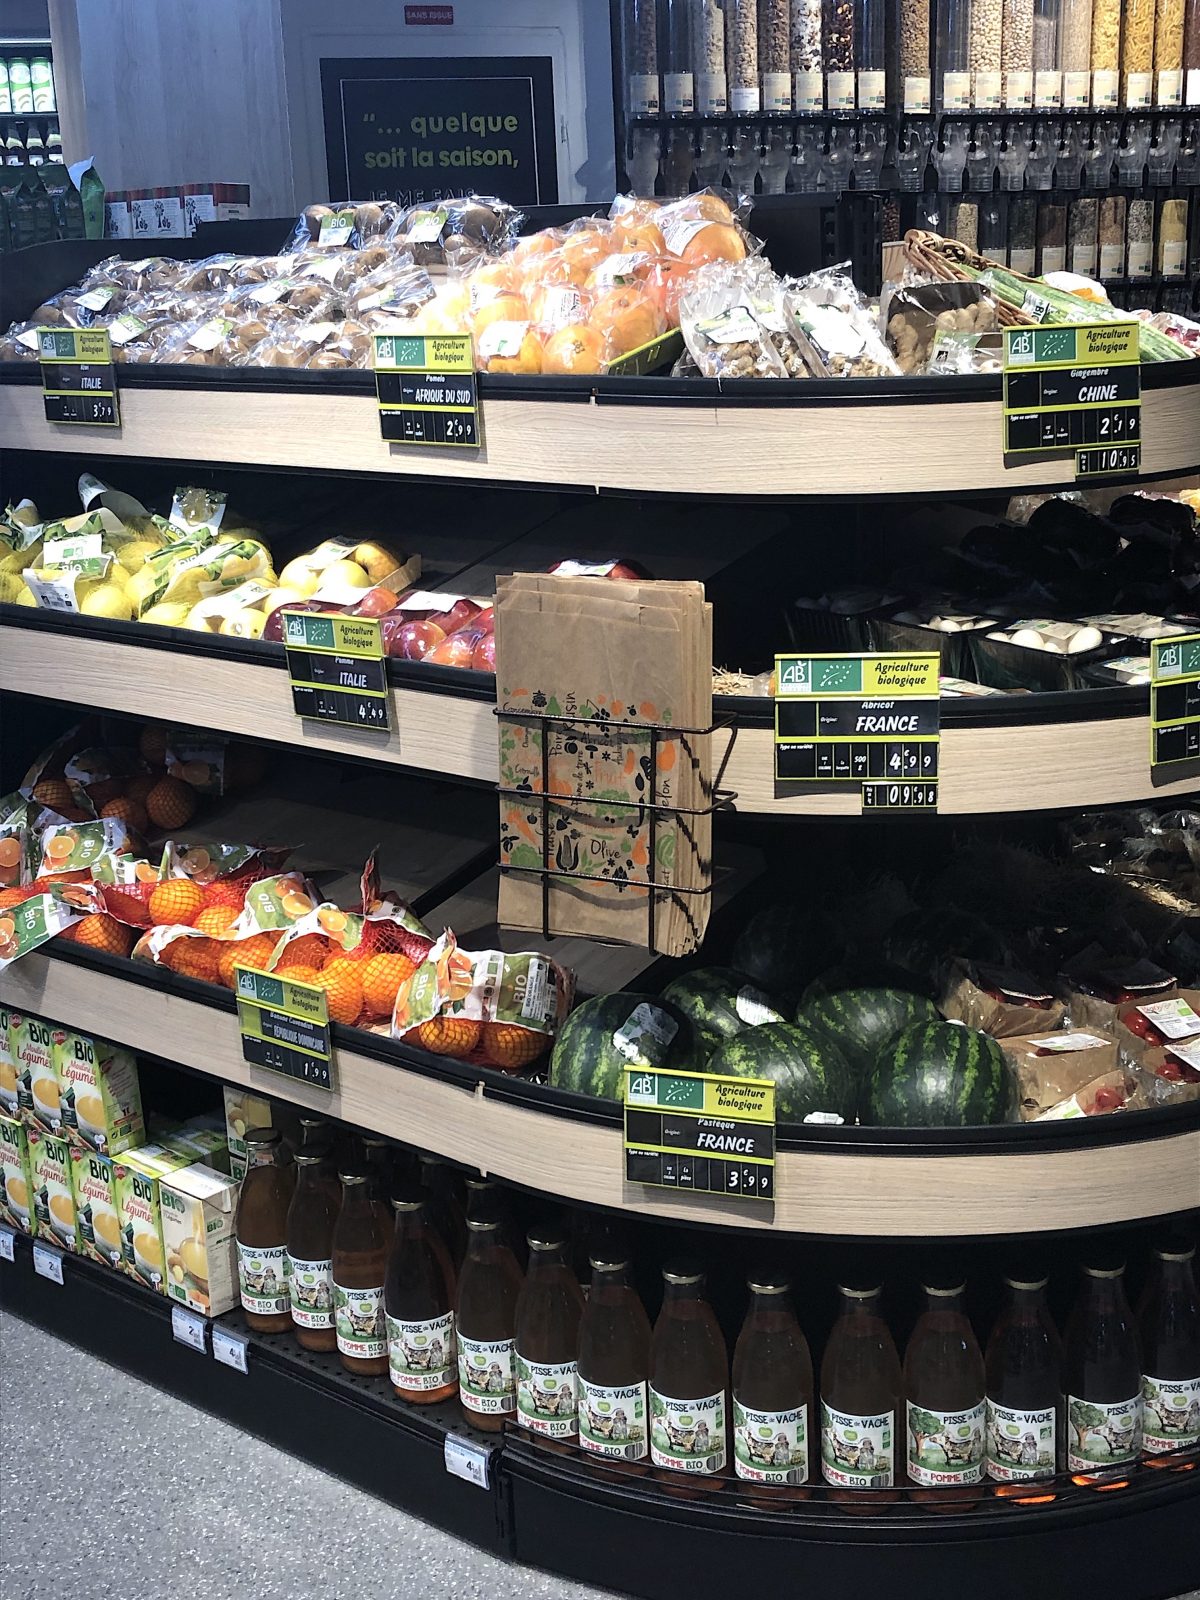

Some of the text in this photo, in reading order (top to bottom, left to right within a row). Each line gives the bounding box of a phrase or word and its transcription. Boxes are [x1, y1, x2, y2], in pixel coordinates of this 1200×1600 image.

[410, 112, 519, 138] quelque
[364, 146, 519, 169] soit la saison,
[330, 217, 346, 228] BIO
[377, 340, 466, 357] AB Agriculture
[1011, 329, 1131, 354] AB Agriculture
[1088, 342, 1128, 354] biologique
[434, 353, 464, 363] biologique
[1070, 368, 1110, 379] Gingembre
[81, 377, 102, 389] ITALIE
[415, 389, 471, 404] AFRIQUE DU SUD
[1078, 384, 1118, 402] CHINE
[288, 620, 374, 636] AB Agriculture
[343, 637, 373, 648] biologique
[1159, 649, 1177, 667] AB
[782, 661, 930, 682] AB Agriculture
[339, 672, 367, 688] ITALIE
[877, 675, 926, 687] biologique
[861, 701, 895, 709] Abricot
[855, 715, 919, 732] FRANCE
[854, 755, 867, 763] 500
[81, 840, 95, 859] BIO
[590, 838, 621, 859] Olive
[258, 893, 275, 913] BIO
[240, 974, 320, 1002] AB Agriculture
[415, 973, 429, 1000] BIO
[513, 974, 527, 1003] BIO
[292, 997, 319, 1012] biologique
[28, 1022, 50, 1047] Bio
[74, 1040, 94, 1064] Bio
[631, 1076, 766, 1098] AB Agriculture
[717, 1098, 763, 1111] biologique
[1, 1124, 19, 1148] Bio
[696, 1133, 755, 1153] FRANCE
[45, 1140, 65, 1165] Bio
[89, 1159, 109, 1183] Bio
[133, 1177, 152, 1203] Bio
[161, 1190, 185, 1214] BIO
[207, 1219, 223, 1233] BIO
[263, 1248, 287, 1259] VACHE
[316, 1263, 332, 1272] VAC
[347, 1291, 368, 1300] PISSE
[257, 1301, 272, 1309] BIO
[311, 1315, 326, 1324] BIO
[401, 1315, 453, 1333] PISSE VACHE
[343, 1341, 384, 1352] POMME BIO
[463, 1341, 515, 1353] PISSE VACHE
[397, 1372, 439, 1385] POMME BIO
[530, 1365, 577, 1376] PISSE VAC
[586, 1385, 641, 1399] PISSE VACHE
[1159, 1383, 1184, 1393] PISSE
[481, 1399, 497, 1408] BIO
[665, 1396, 721, 1412] PISSE VACHE
[1107, 1403, 1129, 1416] PISSE
[746, 1409, 803, 1424] PISSE VACHE
[831, 1412, 889, 1428] PISSE VACHE
[943, 1415, 967, 1424] PISSE
[994, 1407, 1053, 1424] PISSE VACHE
[523, 1416, 566, 1432] POMME BIO
[1146, 1436, 1176, 1449] POMME
[604, 1447, 621, 1456] BIO
[658, 1454, 703, 1470] POMME BIO
[987, 1462, 1010, 1478] OMME
[739, 1463, 783, 1482] POMME BIO
[908, 1463, 978, 1483] JUS POMME BIO
[849, 1477, 867, 1486] BIO
